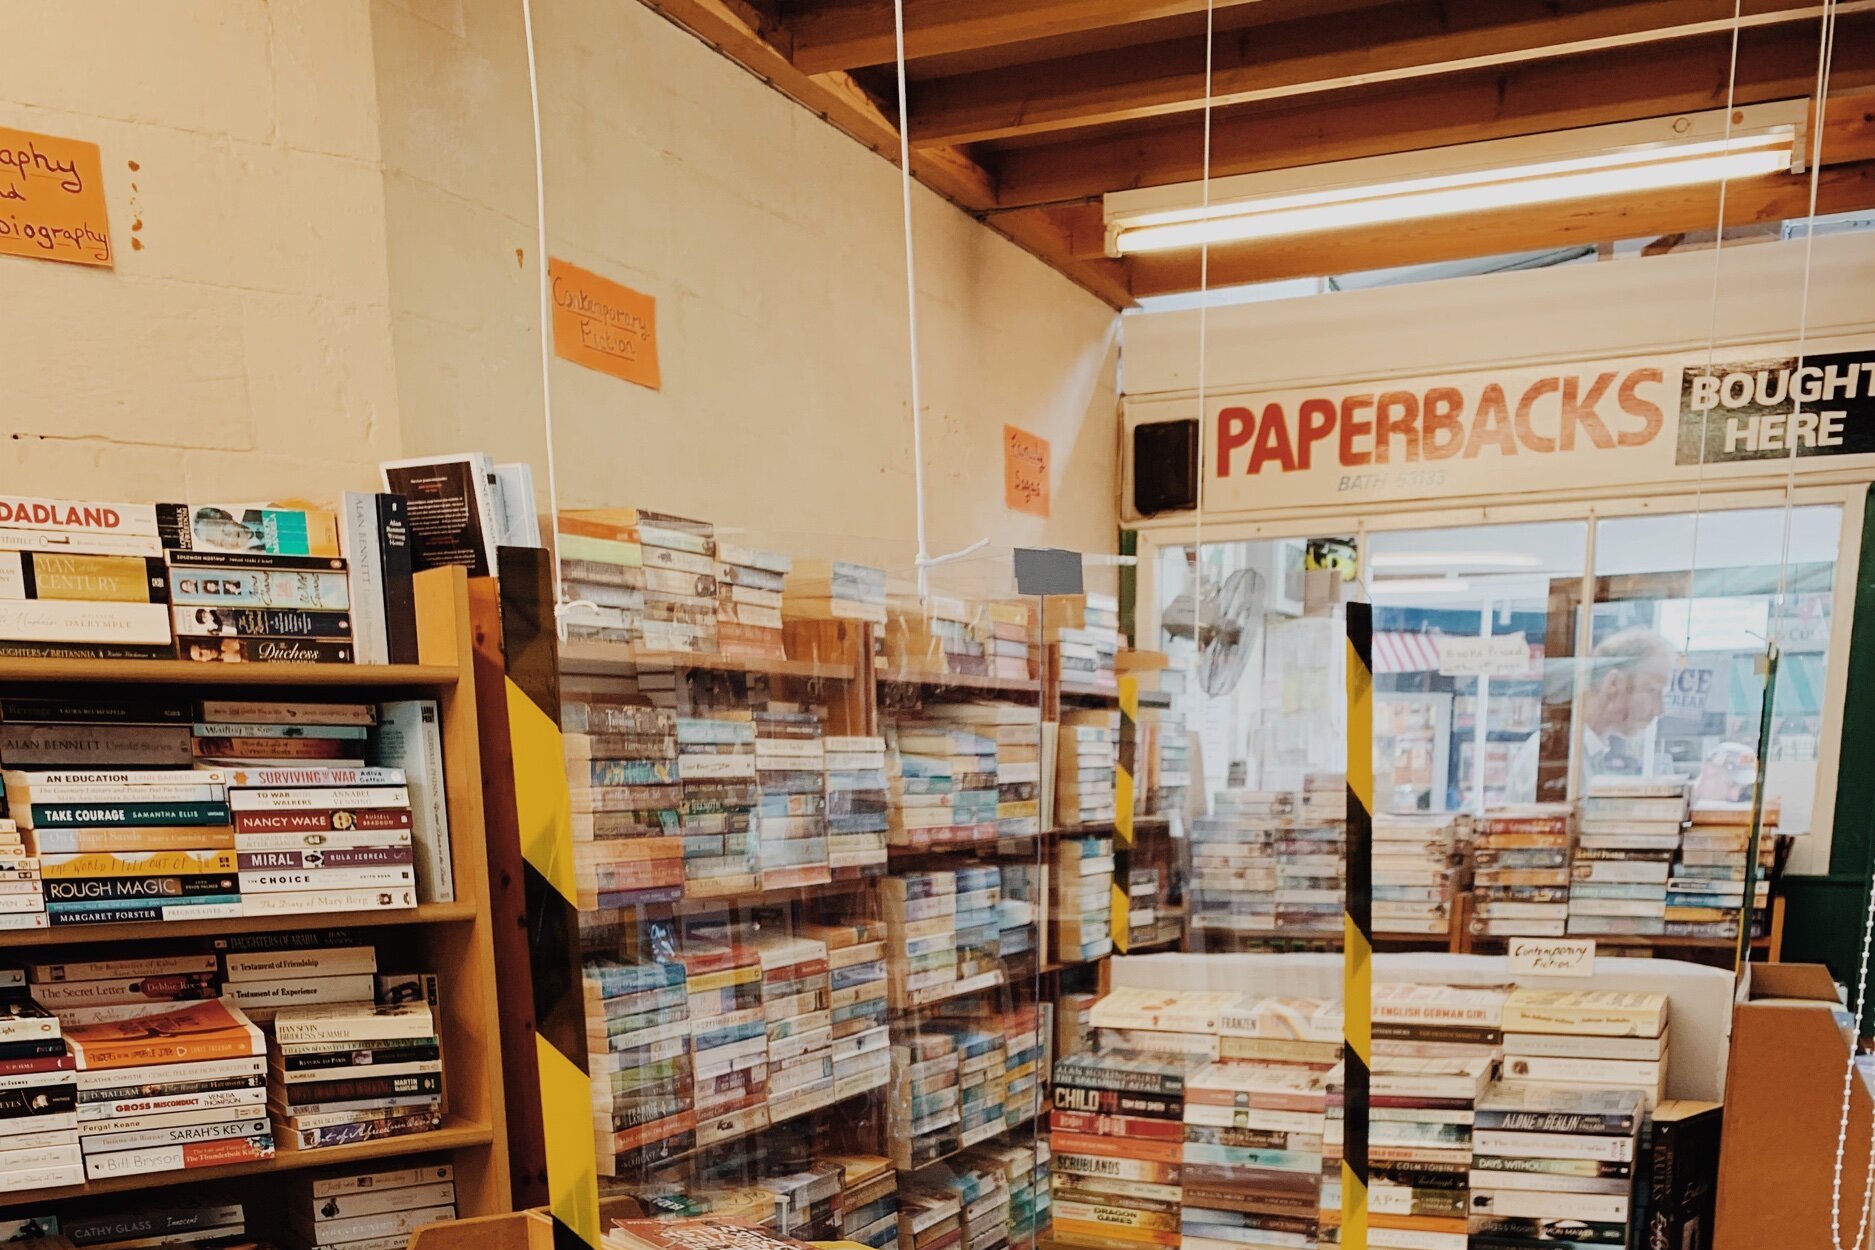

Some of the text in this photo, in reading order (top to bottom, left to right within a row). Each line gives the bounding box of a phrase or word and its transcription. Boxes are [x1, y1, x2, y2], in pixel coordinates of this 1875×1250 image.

[1691, 362, 1875, 411] BOUGHT
[1216, 367, 1664, 478] PAPERBACKS
[1724, 410, 1848, 454] HERE
[1337, 471, 1388, 492] BATH
[0, 502, 121, 529] DADLAND
[37, 574, 119, 593] CENTURY
[259, 642, 320, 660] Duchess
[44, 740, 100, 750] BENNETT
[65, 775, 129, 783] EDUCATION
[259, 770, 356, 785] SURVIVING WAR
[45, 810, 74, 822] TAKE
[76, 809, 126, 822] COURAGE
[133, 811, 176, 819] SAMANTHA
[243, 816, 326, 828] NANCY WAKE
[251, 853, 295, 867] MIRAL
[260, 875, 311, 885] CHOICE
[51, 883, 112, 899] ROUGH
[117, 879, 177, 895] MAGIC
[60, 911, 156, 924] MARGARET FORSTER
[1514, 944, 1588, 963] Contemporary
[240, 958, 319, 971] Testament Friendship
[40, 985, 127, 998] The Secret Letter
[236, 987, 318, 999] Testament Experience
[1380, 1006, 1488, 1020] ENGLISH GERMAN GIRL
[1221, 1016, 1257, 1031] FRANZEN
[101, 1088, 139, 1099] BALLAM
[1055, 1087, 1099, 1112] CHILD
[115, 1098, 200, 1113] GROSS MISCONDUCT
[83, 1120, 140, 1133] Fergal Keane
[1502, 1113, 1579, 1129] ALONE BERLIN
[170, 1123, 245, 1141] SARAH'S KEY
[134, 1153, 181, 1168] Bryson
[1057, 1154, 1121, 1175] SCRUBLANDS
[1093, 1207, 1138, 1218] DRAGON
[1096, 1214, 1133, 1225] GAMES
[75, 1221, 151, 1239] CATHY GLASS
